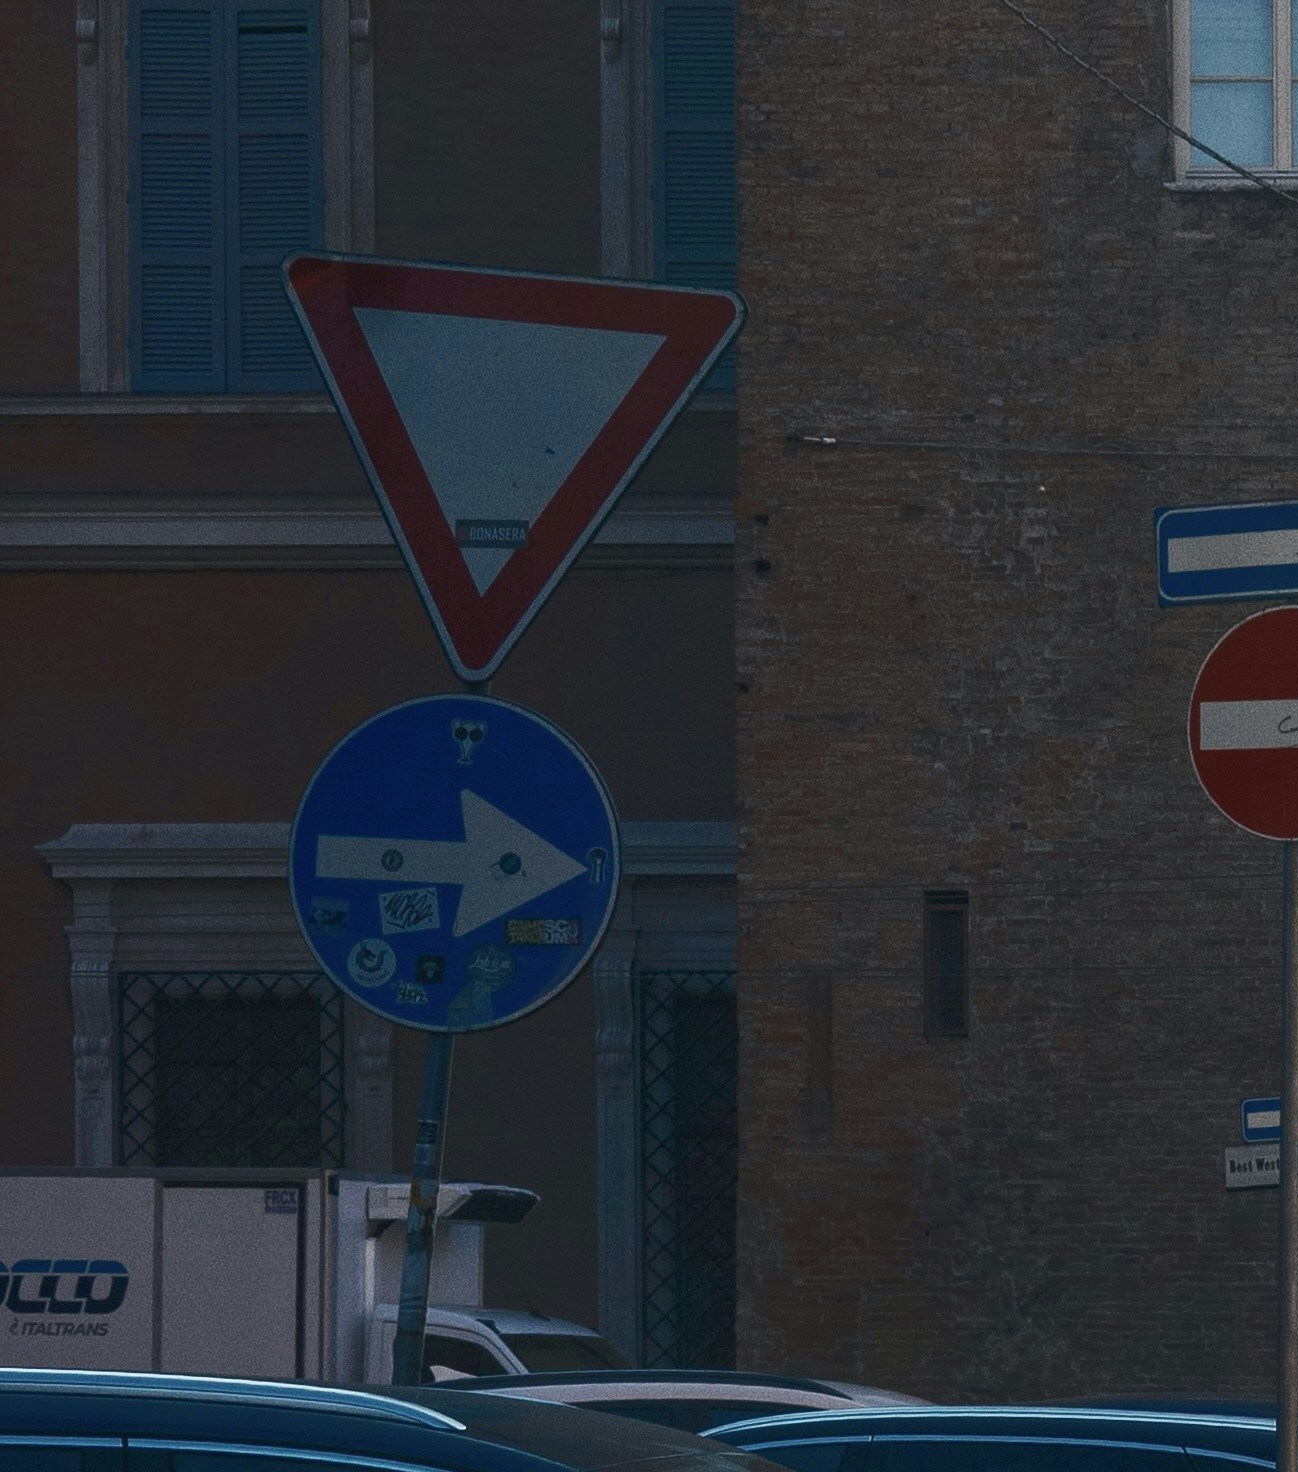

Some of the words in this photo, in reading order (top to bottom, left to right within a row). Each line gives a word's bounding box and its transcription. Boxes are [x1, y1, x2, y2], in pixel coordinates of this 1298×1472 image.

[469, 526, 526, 541] BONASERA
[1229, 1159, 1253, 1173] Best
[1255, 1157, 1281, 1171] West
[0, 1258, 129, 1314] CCO
[21, 1321, 109, 1336] ITALTRANS
